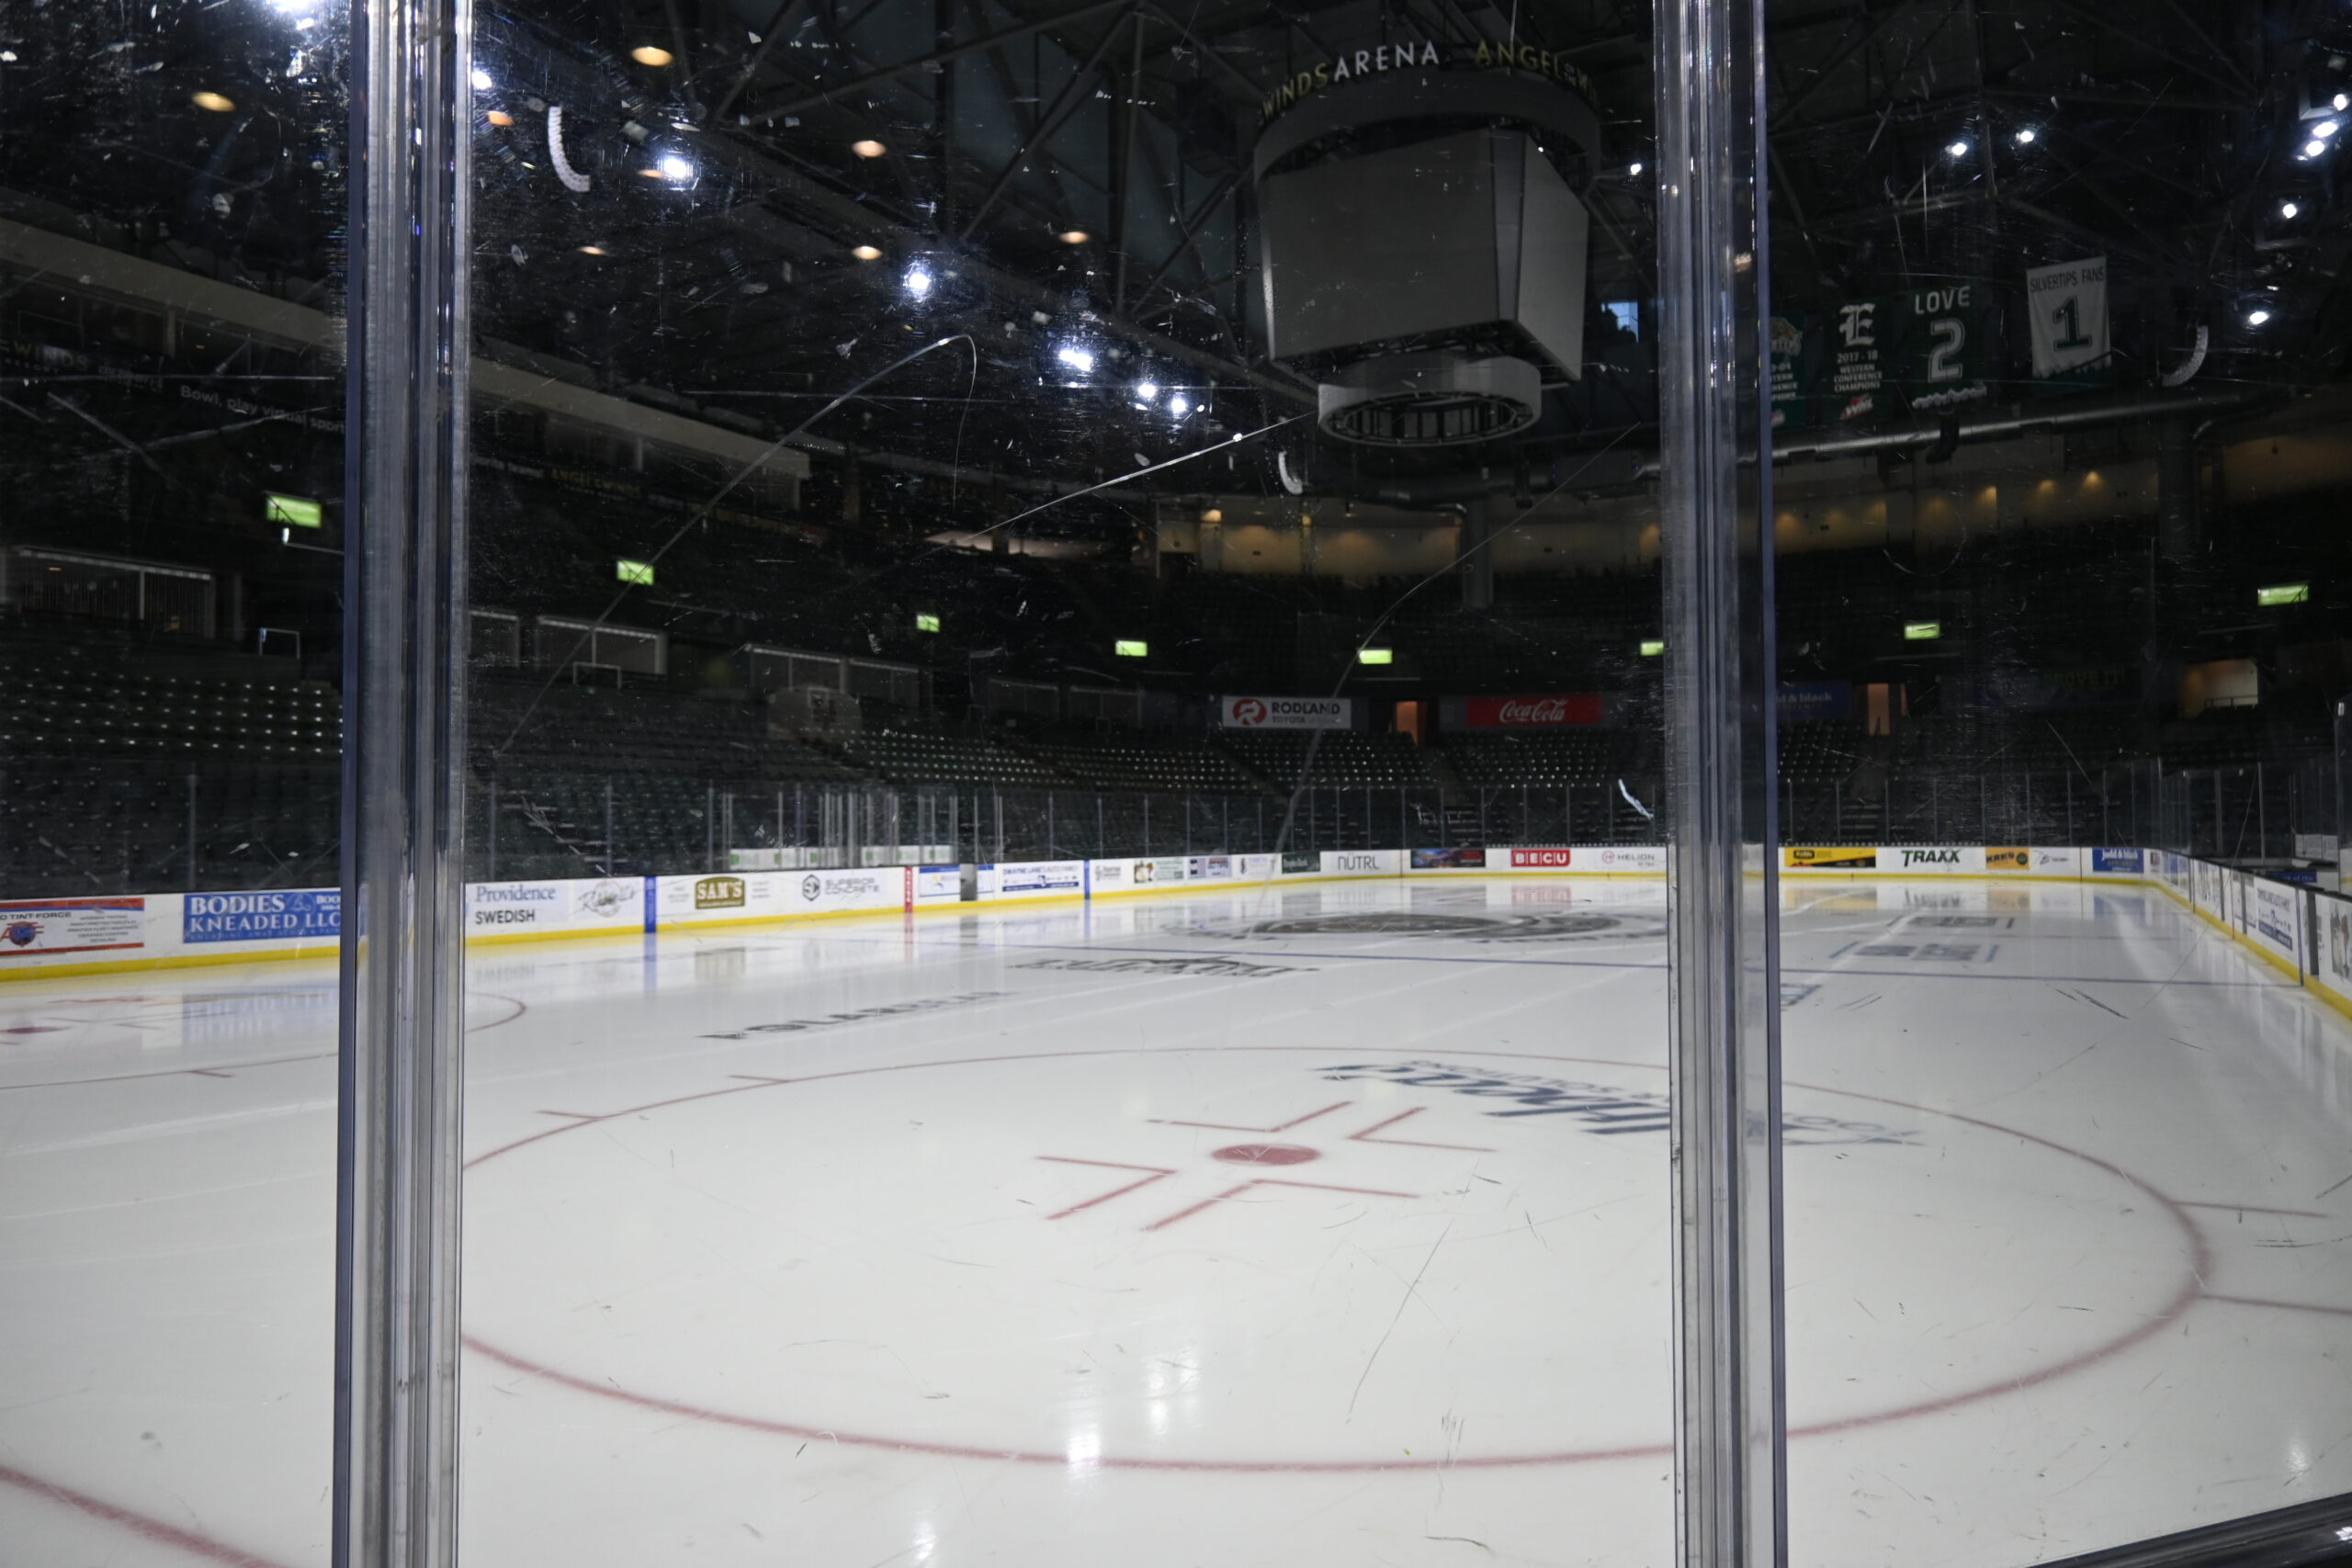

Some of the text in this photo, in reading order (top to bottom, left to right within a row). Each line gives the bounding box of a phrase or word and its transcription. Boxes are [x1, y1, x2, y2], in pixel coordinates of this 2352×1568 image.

[1475, 39, 1563, 81] ANGEL
[1261, 39, 1440, 120] WINDS ARENA
[2030, 266, 2104, 294] SILVERTIPS FANS
[1915, 285, 1971, 315] LOVE
[1839, 302, 1876, 348] E
[2053, 294, 2093, 354] 1
[1837, 351, 1859, 365] 2017
[1868, 349, 1879, 361] 18
[1928, 318, 1966, 384] 2
[1834, 371, 1883, 384] CONFERENCE
[1839, 364, 1875, 376] WESTERN
[1834, 380, 1882, 394] CHAMPIONS
[180, 385, 223, 408] Bowl,
[227, 398, 258, 416] play
[1272, 702, 1340, 715] RODLAND
[1514, 852, 1567, 864] BECU
[1617, 852, 1655, 862] HELION
[1901, 849, 1962, 868] TRAXX
[696, 880, 743, 900] SAM'S
[825, 876, 876, 887] SUPERIOR
[825, 885, 879, 896] CONCRETE
[476, 884, 556, 902] Providence
[190, 894, 286, 916] BODIES
[11, 912, 33, 920] TINT
[35, 911, 72, 919] FORCE
[190, 911, 340, 932] KNEADED LLC
[475, 909, 536, 925] SWEDISH
